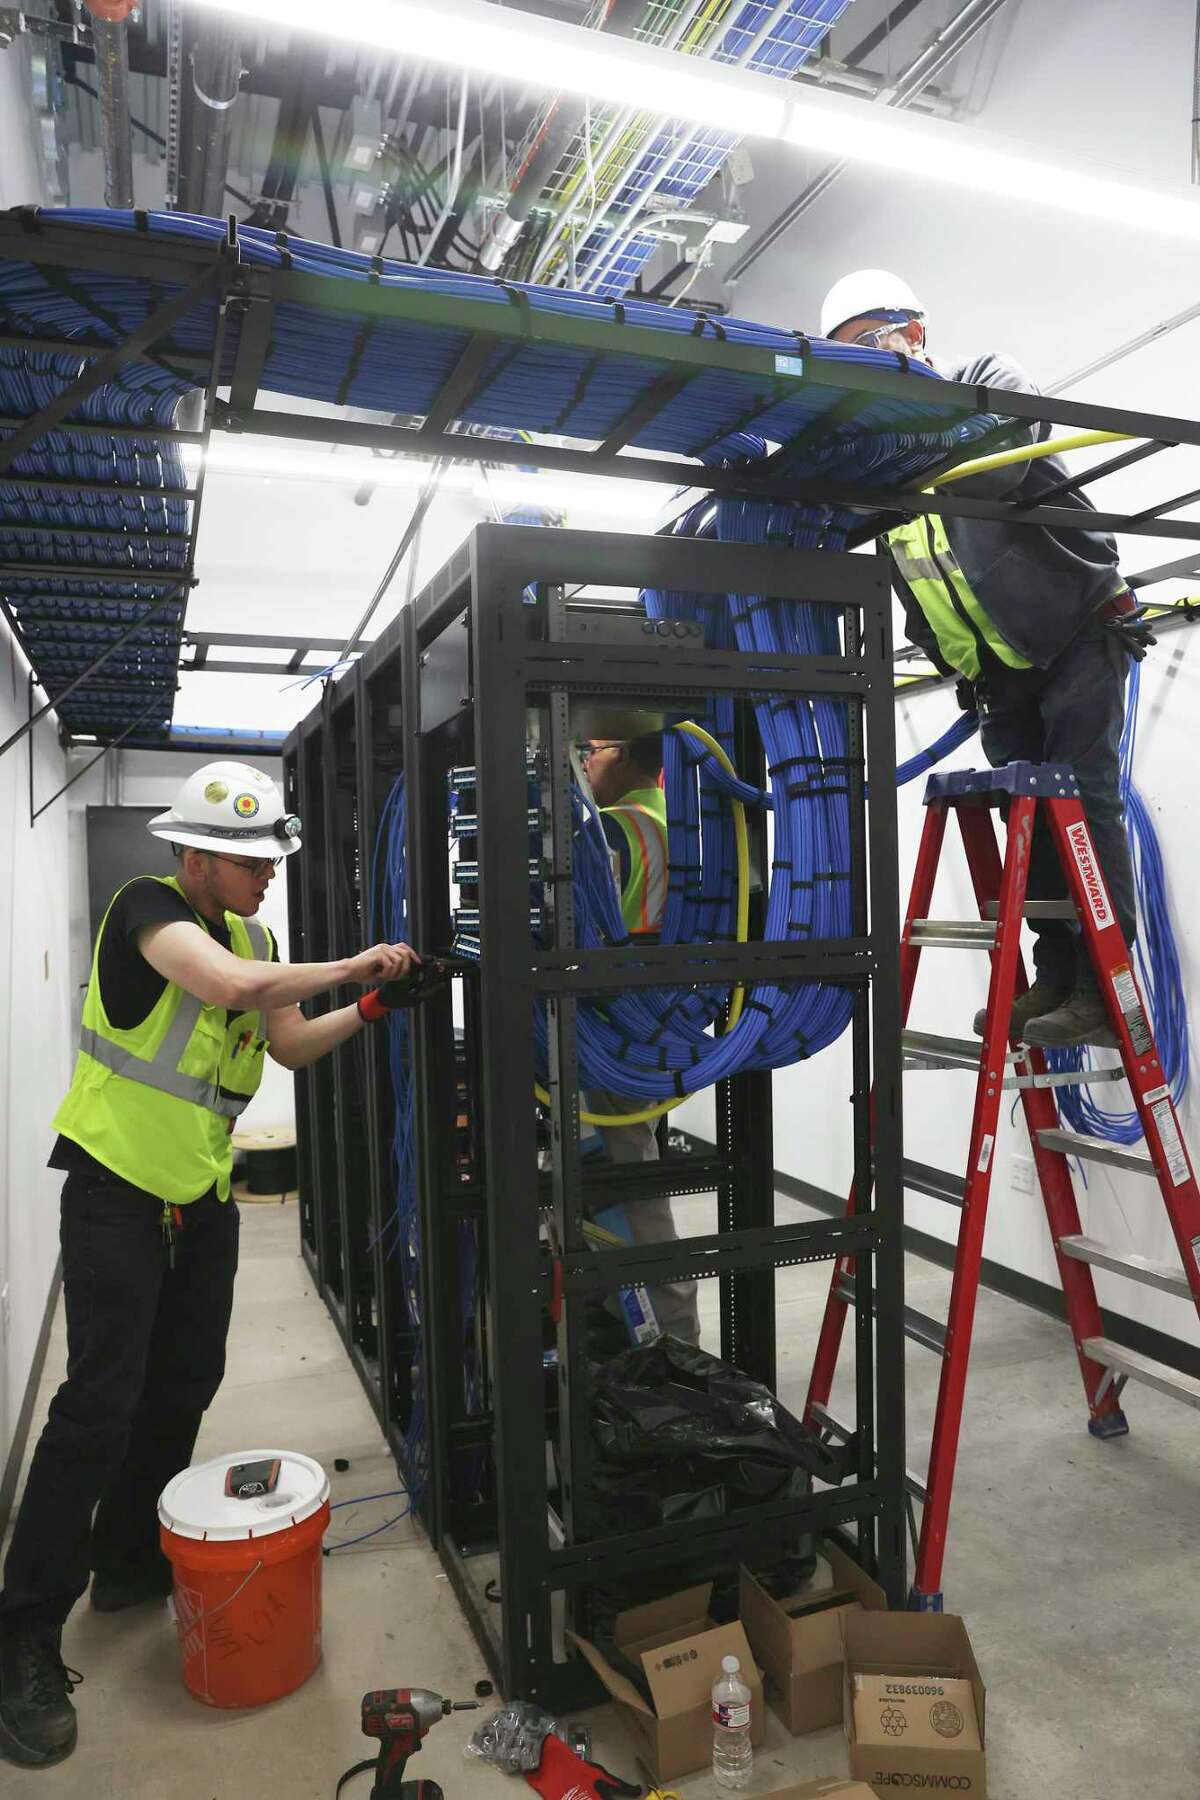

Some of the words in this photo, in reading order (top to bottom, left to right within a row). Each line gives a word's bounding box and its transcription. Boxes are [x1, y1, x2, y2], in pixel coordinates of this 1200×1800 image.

[1071, 827, 1107, 921] WESTWARD
[886, 1684, 945, 1696] 960039832
[874, 1772, 971, 1789] COMMSCOPE
